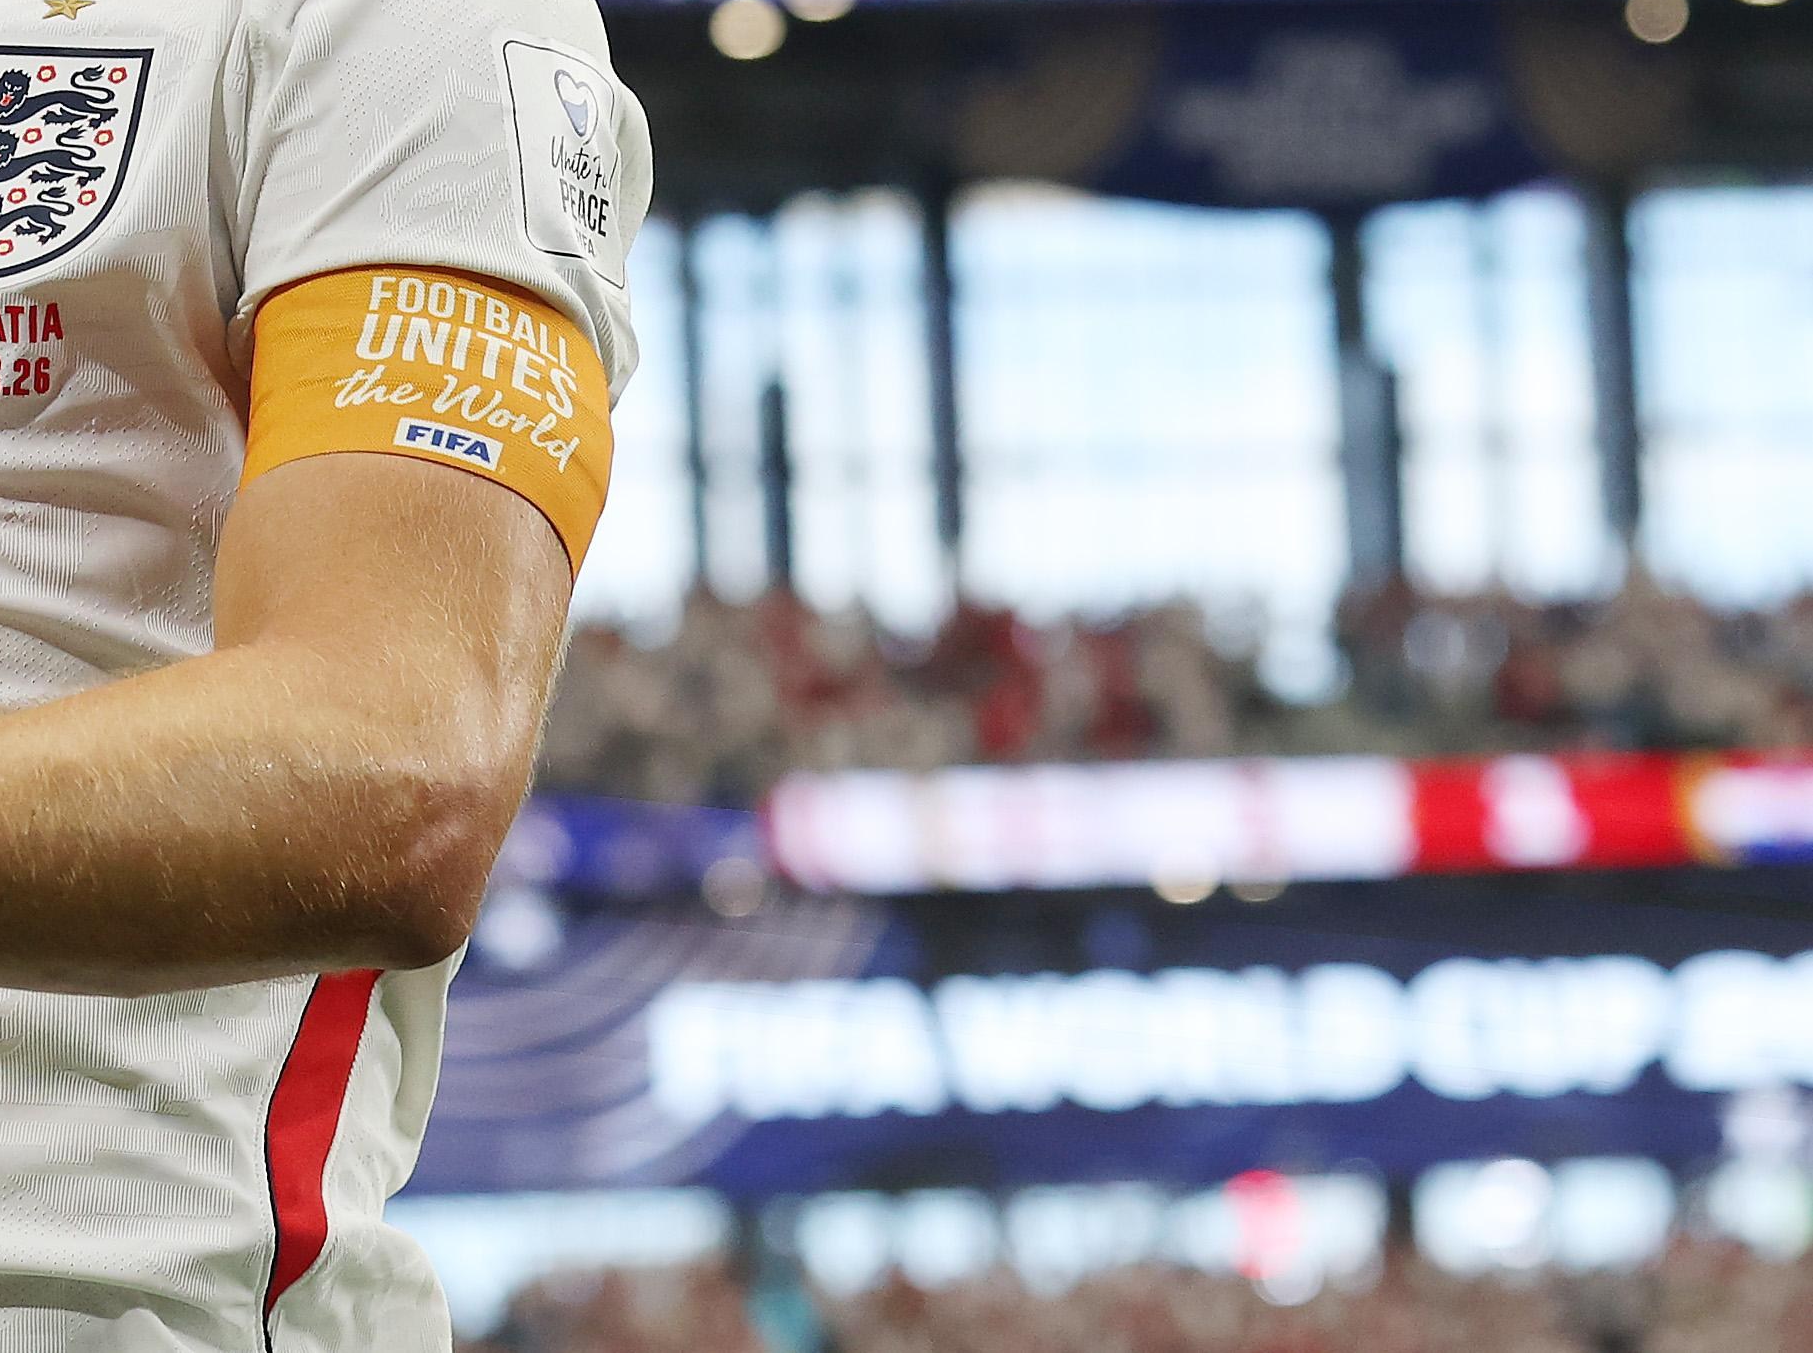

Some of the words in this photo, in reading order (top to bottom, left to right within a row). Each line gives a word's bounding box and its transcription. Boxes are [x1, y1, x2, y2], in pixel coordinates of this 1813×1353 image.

[551, 136, 591, 180] Unite
[559, 178, 609, 237] PEACE
[356, 313, 579, 420] UNITES
[369, 276, 578, 379] FOOTBALL
[332, 364, 424, 409] the
[431, 373, 580, 474] World
[406, 424, 491, 463] FIFA
